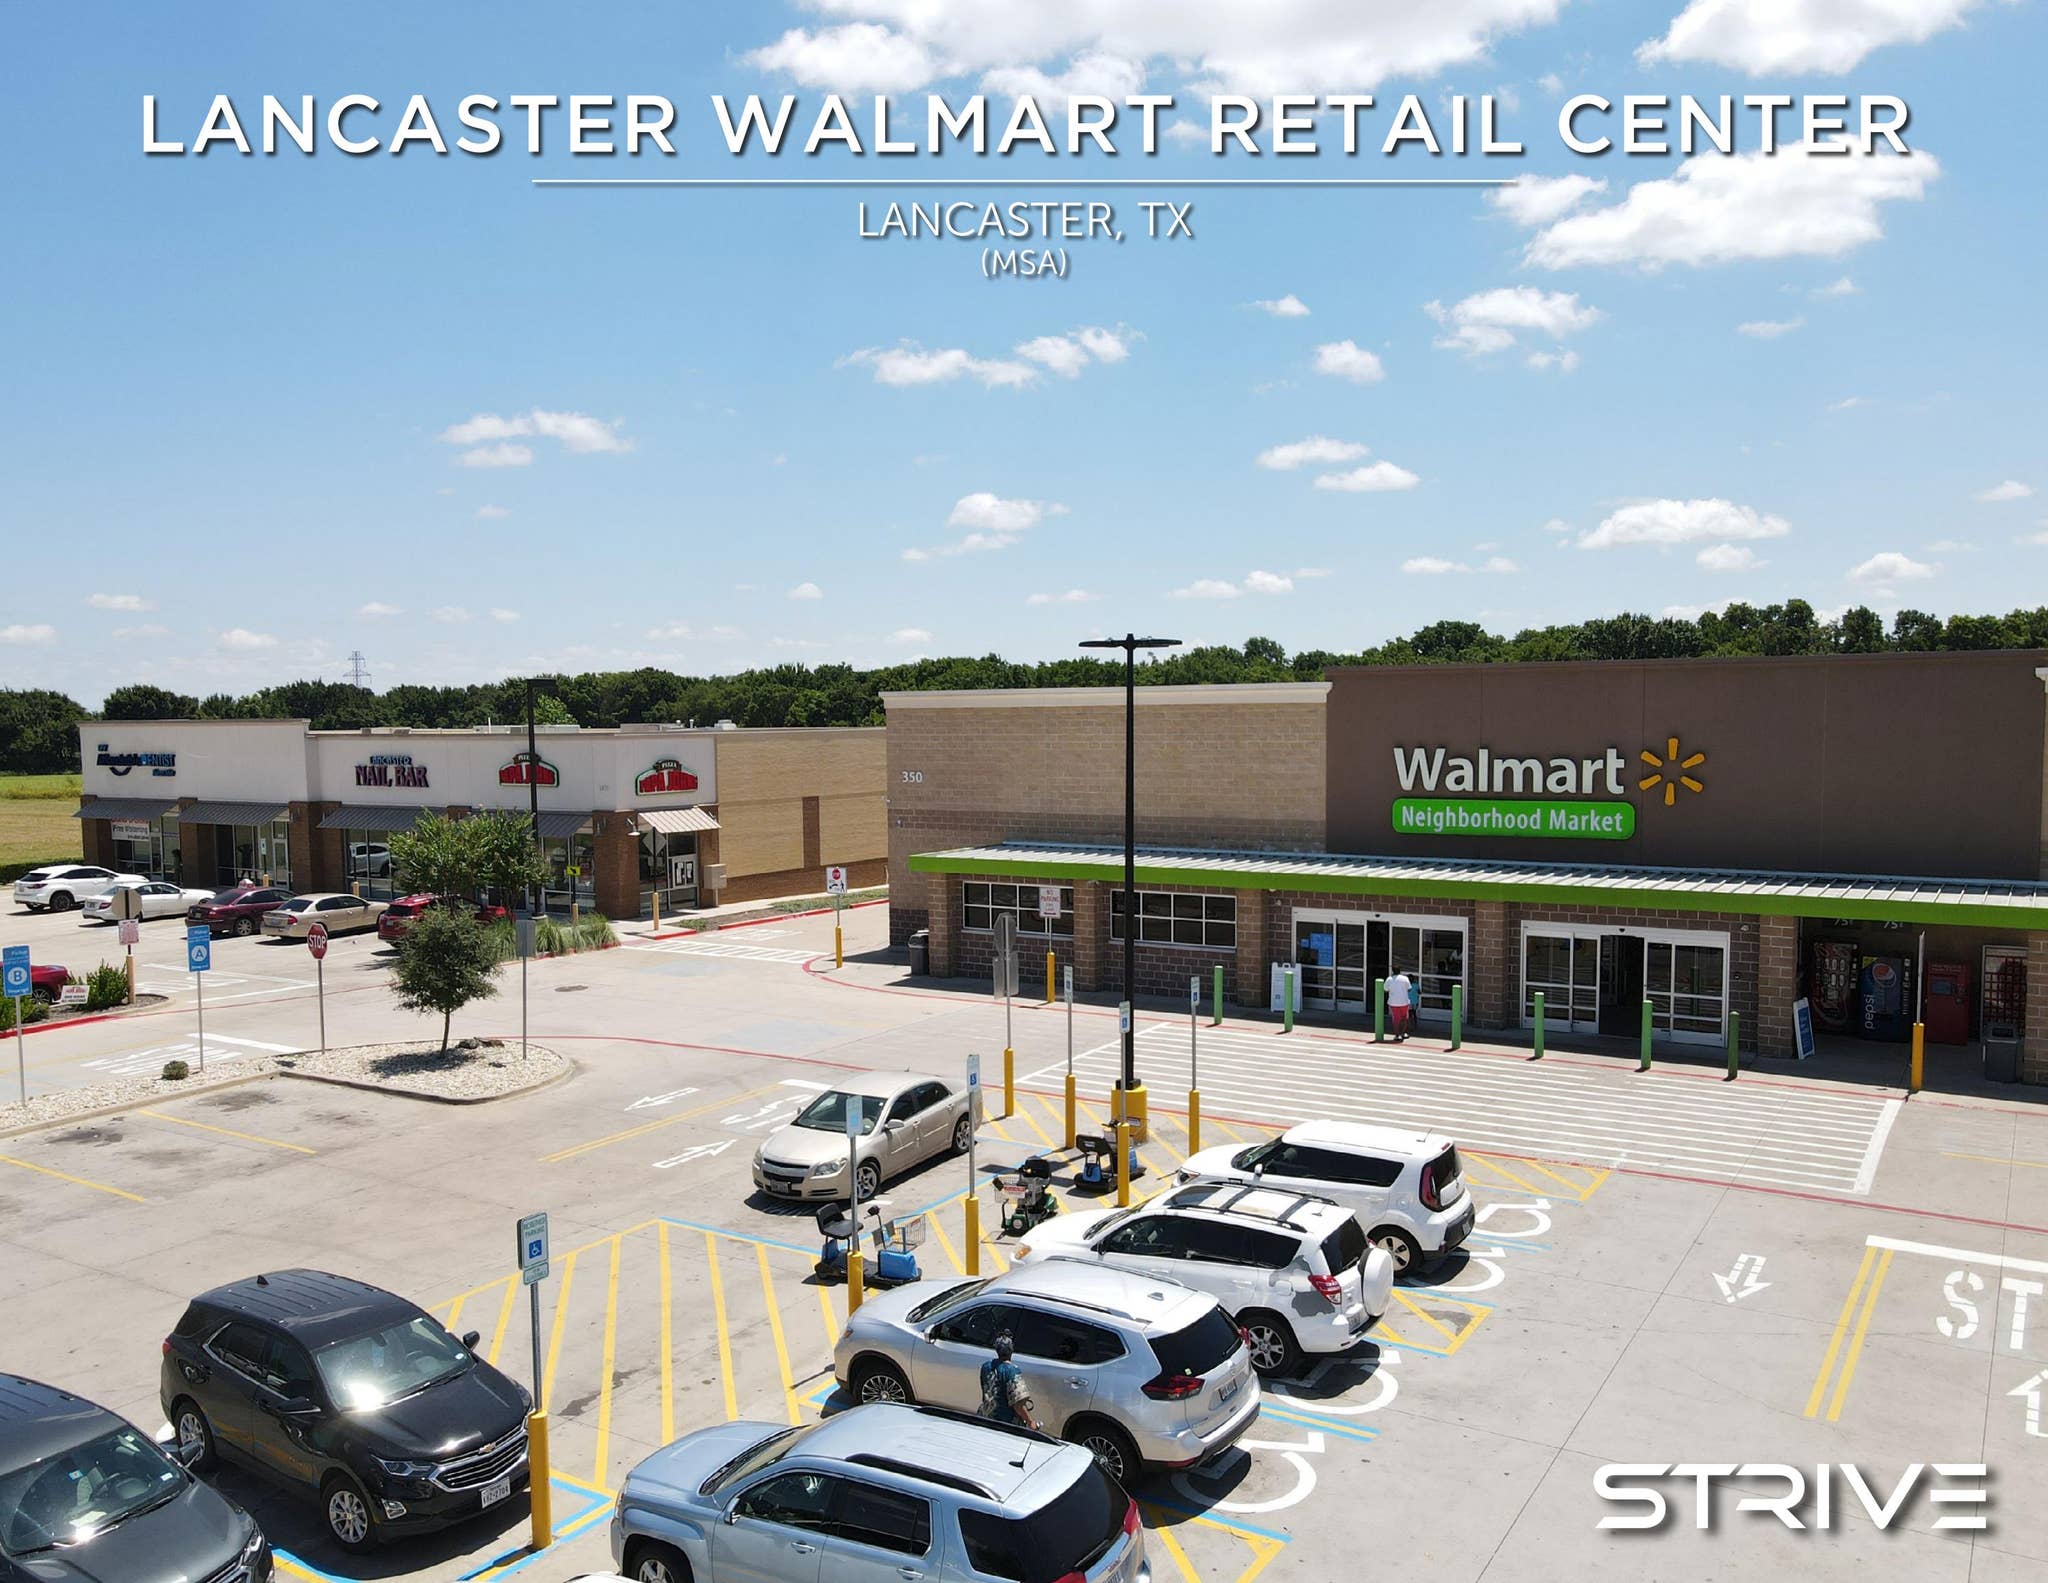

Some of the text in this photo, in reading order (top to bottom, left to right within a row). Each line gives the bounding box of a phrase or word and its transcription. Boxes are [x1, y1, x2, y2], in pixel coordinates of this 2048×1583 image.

[355, 766, 430, 787] NAIL BAR
[902, 771, 923, 783] 350
[1393, 747, 1625, 795] Walmart
[1401, 805, 1624, 832] Neighborhood Market
[309, 934, 326, 949] STOP
[1864, 994, 1876, 1030] pepsi
